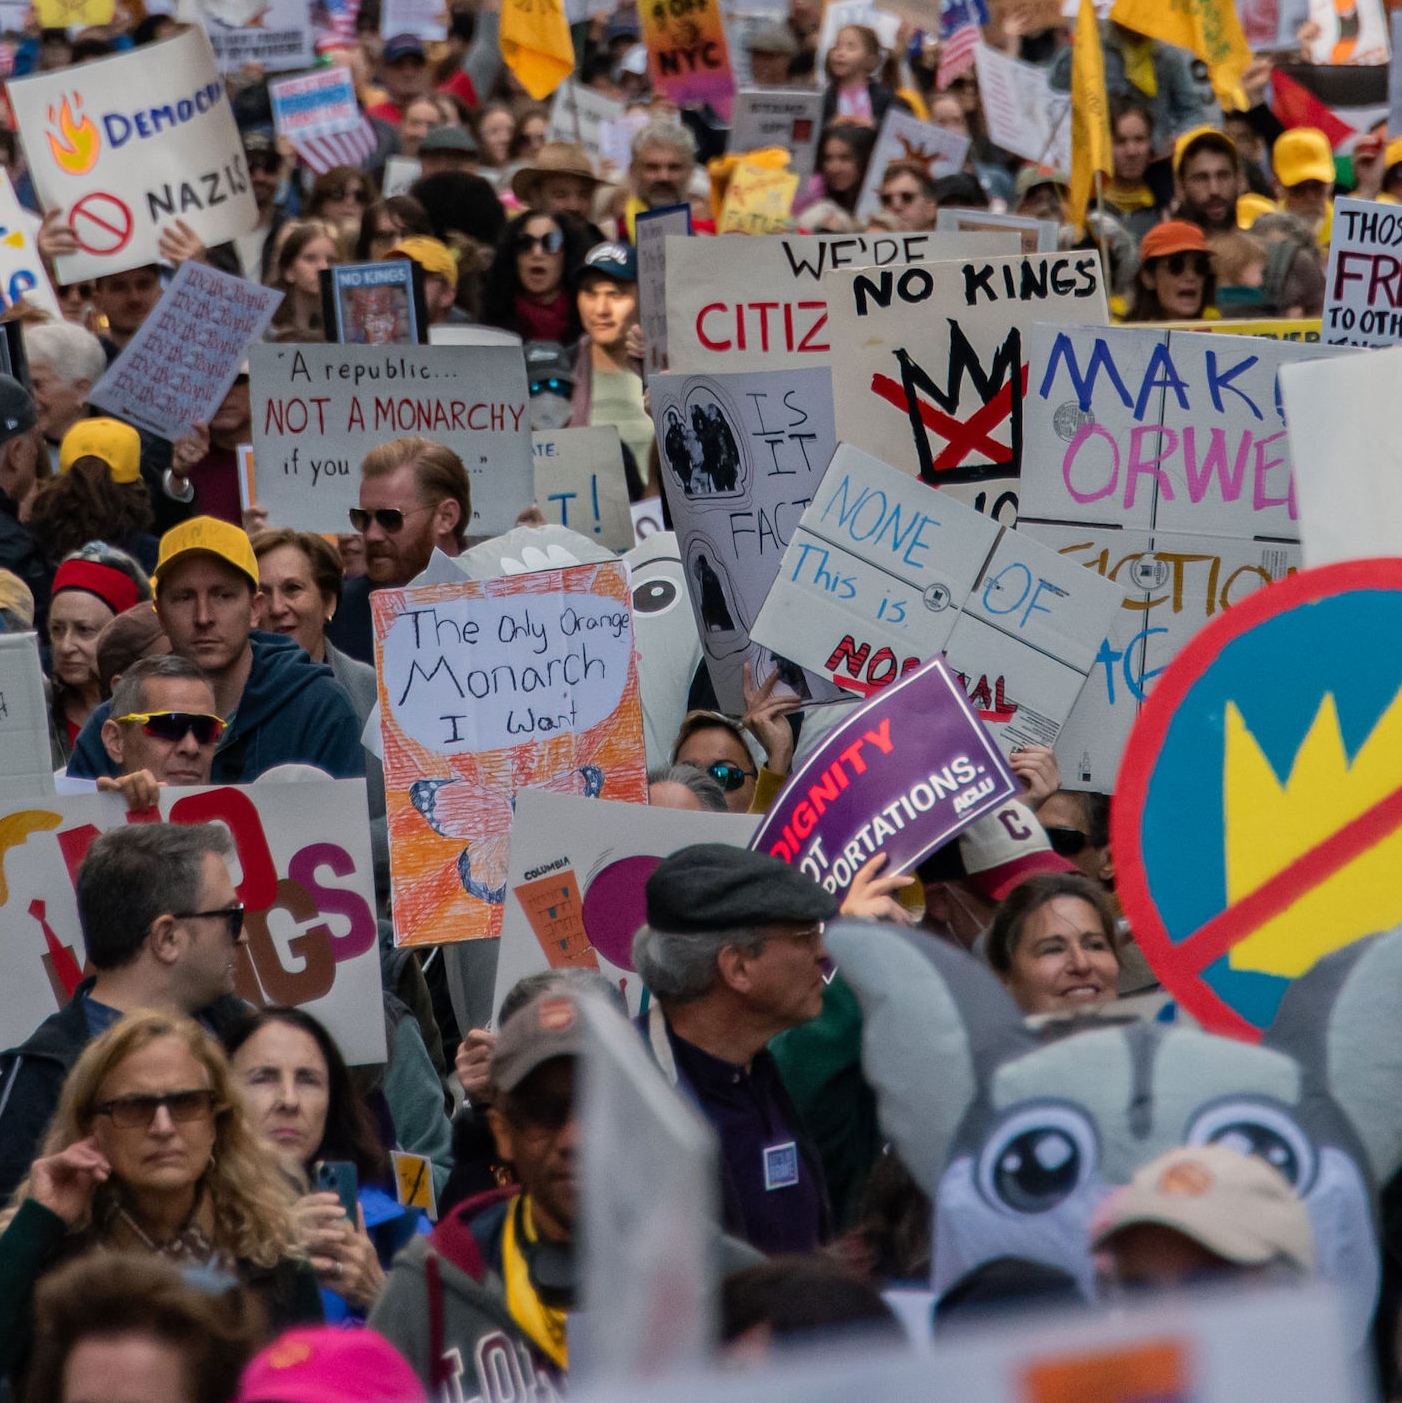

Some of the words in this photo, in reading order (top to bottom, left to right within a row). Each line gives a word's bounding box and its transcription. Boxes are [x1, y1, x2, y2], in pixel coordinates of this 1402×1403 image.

[658, 41, 721, 76] NYC
[146, 154, 248, 225] NAZIS
[339, 270, 361, 287] NO
[364, 266, 407, 284] KINGS
[853, 268, 934, 316] NO
[962, 255, 1098, 306] KINGS
[695, 301, 831, 352] CITIZ
[1327, 307, 1356, 330] TO
[1039, 332, 1289, 428] MAK
[265, 398, 331, 437] NOT
[347, 396, 366, 433] A
[375, 398, 526, 434] MONARCHY
[746, 390, 809, 436] IS
[285, 454, 299, 476] if
[310, 460, 351, 485] you
[764, 432, 817, 477] IT
[1063, 423, 1299, 521] ORWE
[820, 475, 941, 569] NONE
[797, 543, 857, 599] This
[983, 562, 1054, 629] OF
[398, 608, 480, 650] The
[498, 608, 548, 654] Only
[560, 607, 630, 638] Orange
[398, 642, 605, 707] Monarch
[439, 714, 467, 744] I
[507, 700, 578, 735] Want
[770, 717, 895, 865] DIGNITY
[951, 777, 996, 814] ACLU
[822, 755, 985, 895] PORTATIONS.
[997, 809, 1032, 841] C
[524, 855, 571, 881] COLUMBIA
